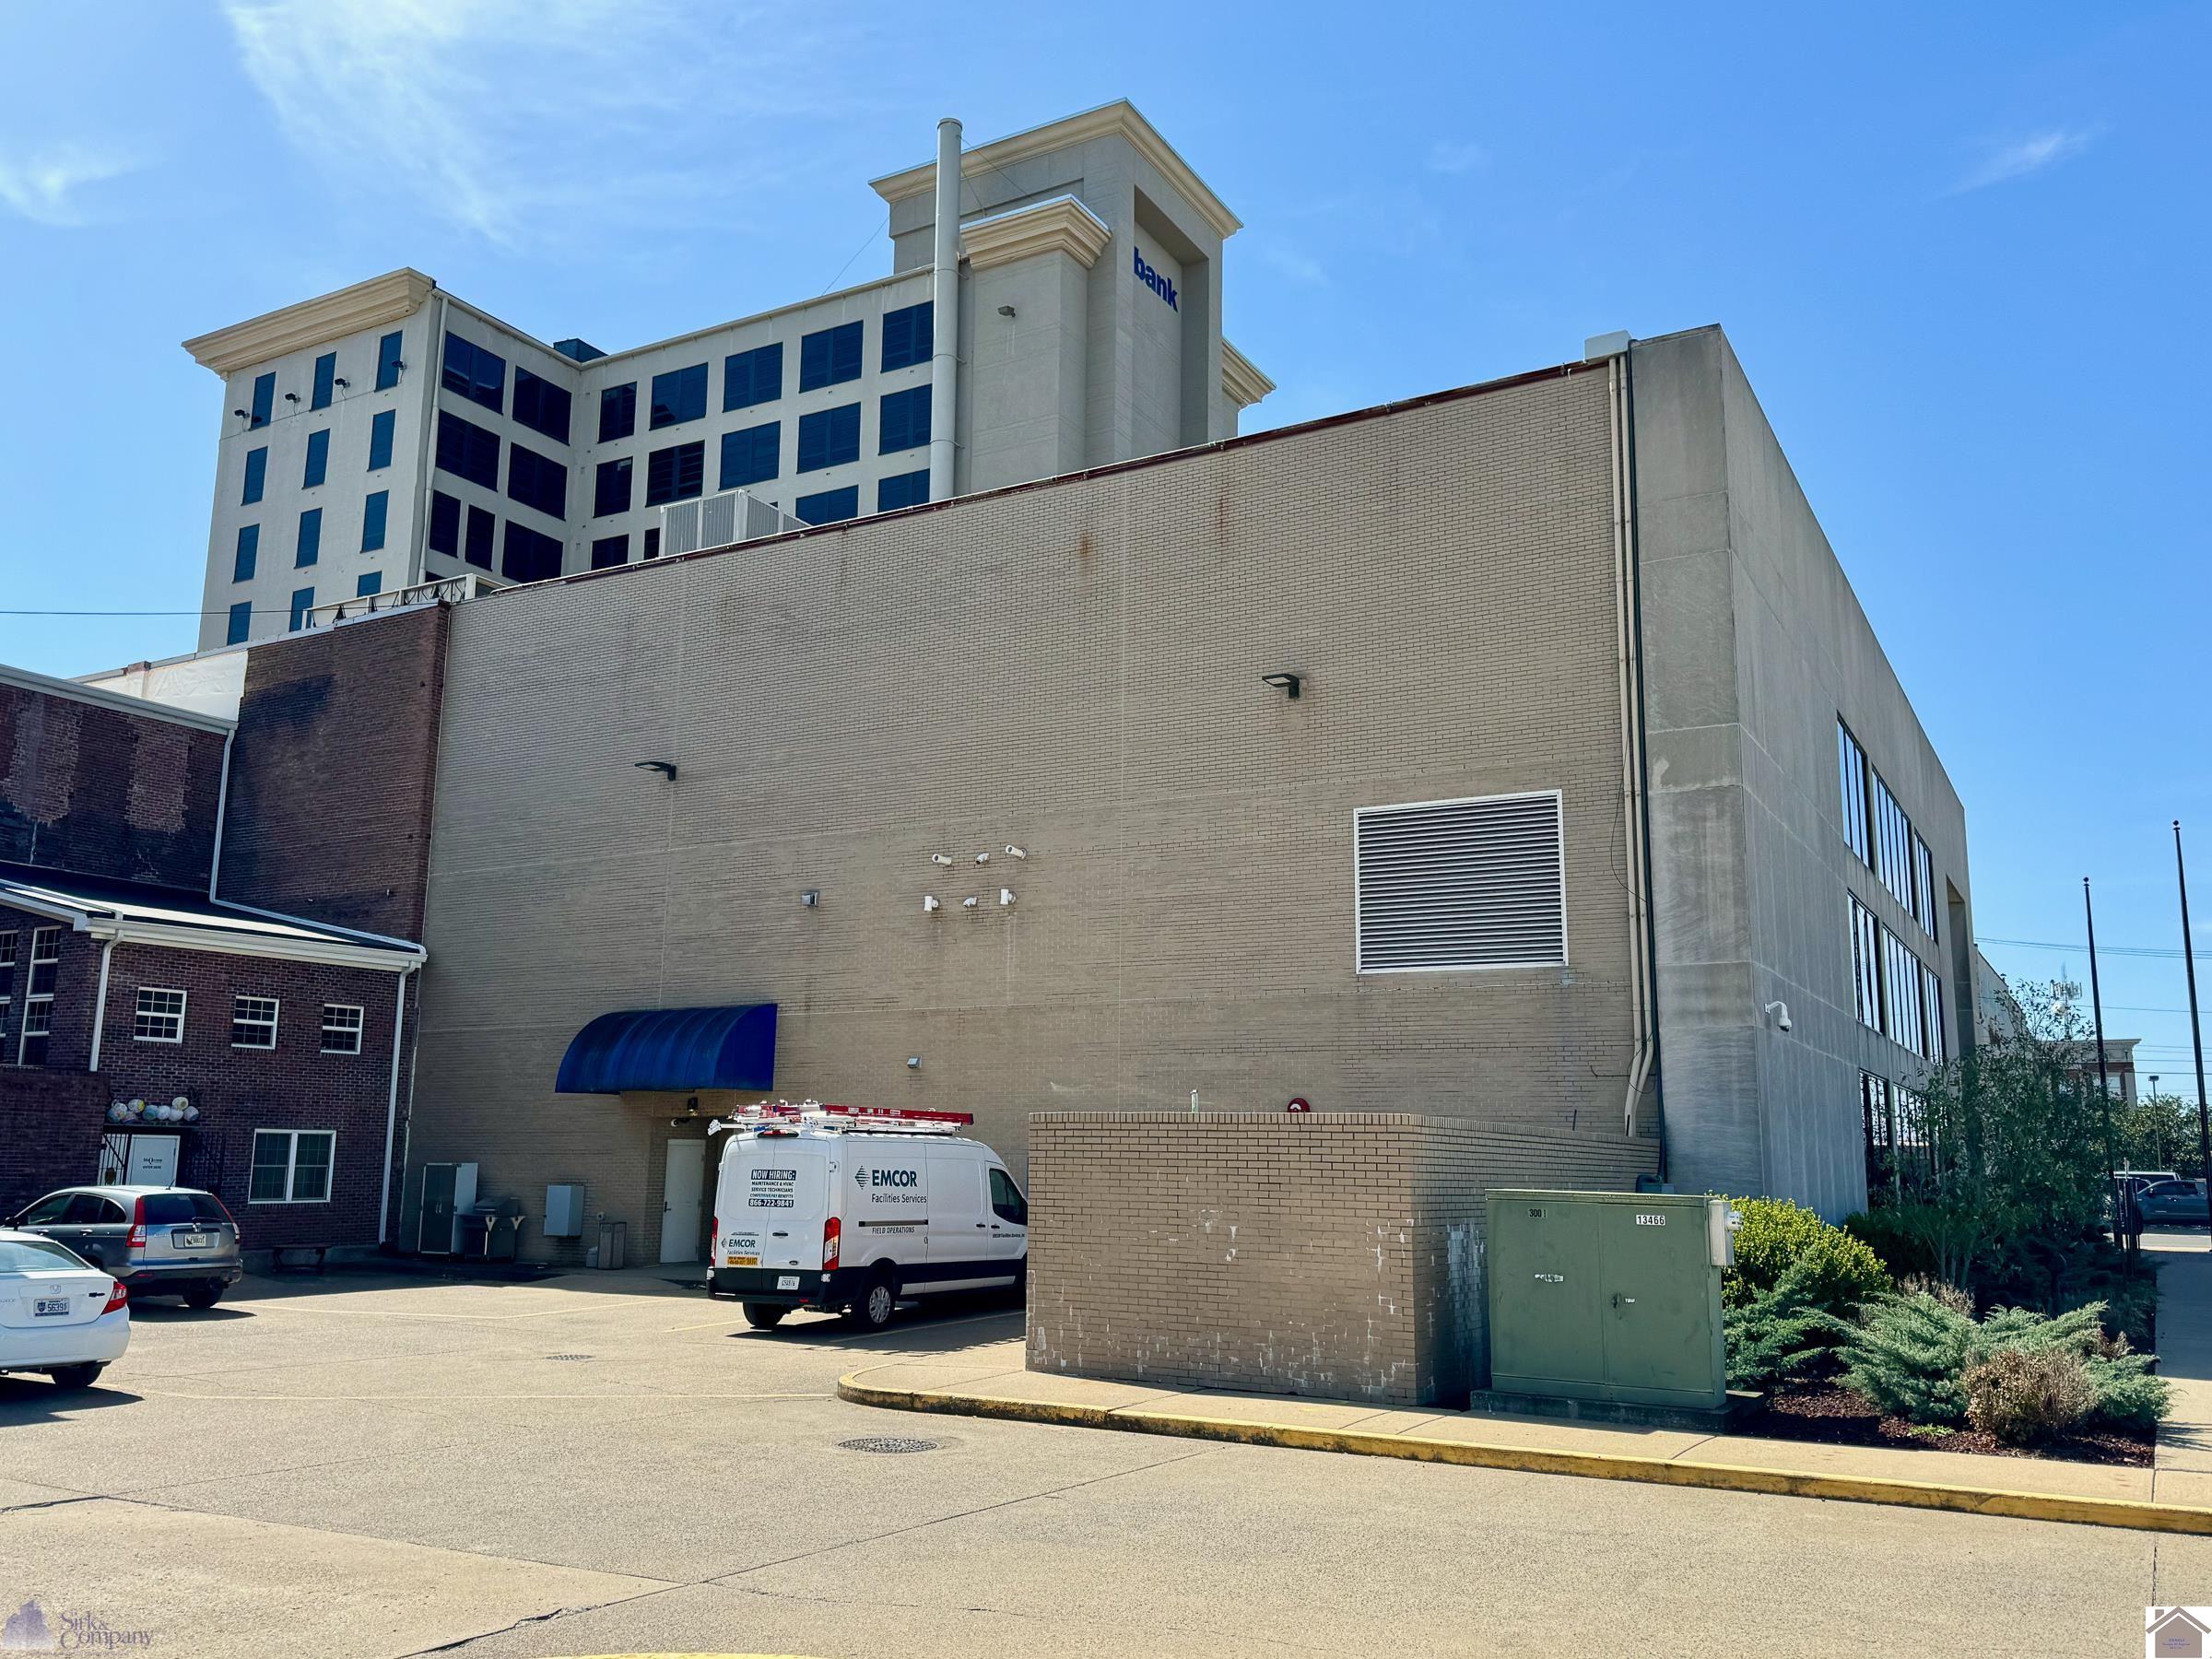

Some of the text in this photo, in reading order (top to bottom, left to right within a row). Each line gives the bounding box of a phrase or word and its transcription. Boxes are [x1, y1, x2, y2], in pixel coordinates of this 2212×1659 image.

[1134, 245, 1179, 313] bank
[752, 1171, 794, 1180] NOW HIRING:
[872, 1170, 918, 1187] EMCOR
[872, 1194, 927, 1203] Facilities Services
[1529, 1208, 1542, 1218] 300
[1638, 1215, 1665, 1225] 13466
[887, 1226, 915, 1234] OPERATIONS
[728, 1239, 756, 1247] EMCOR
